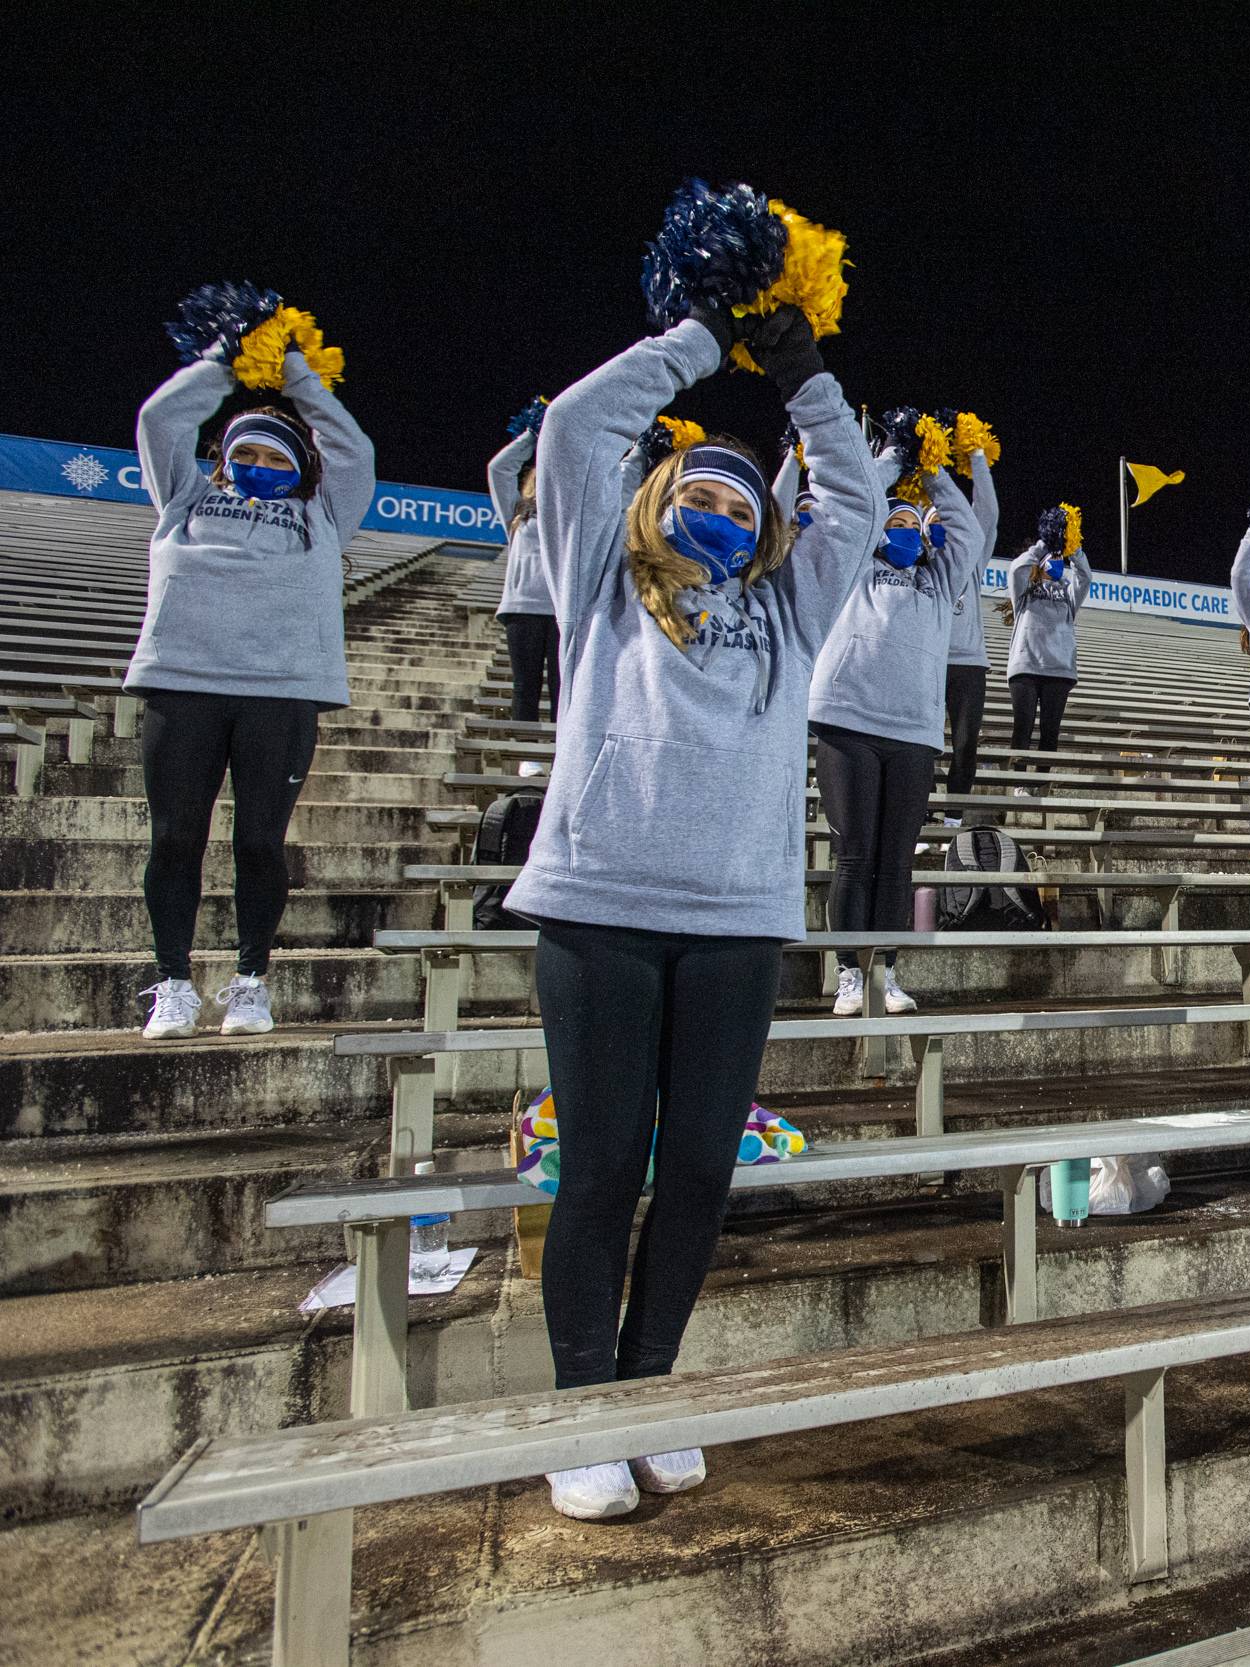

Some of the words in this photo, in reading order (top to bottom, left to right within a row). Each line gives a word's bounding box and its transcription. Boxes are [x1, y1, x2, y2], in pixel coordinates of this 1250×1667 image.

[202, 494, 246, 506] ENT
[196, 506, 252, 521] GOLDEN
[981, 568, 1007, 588] EN
[1191, 594, 1229, 615] CARE
